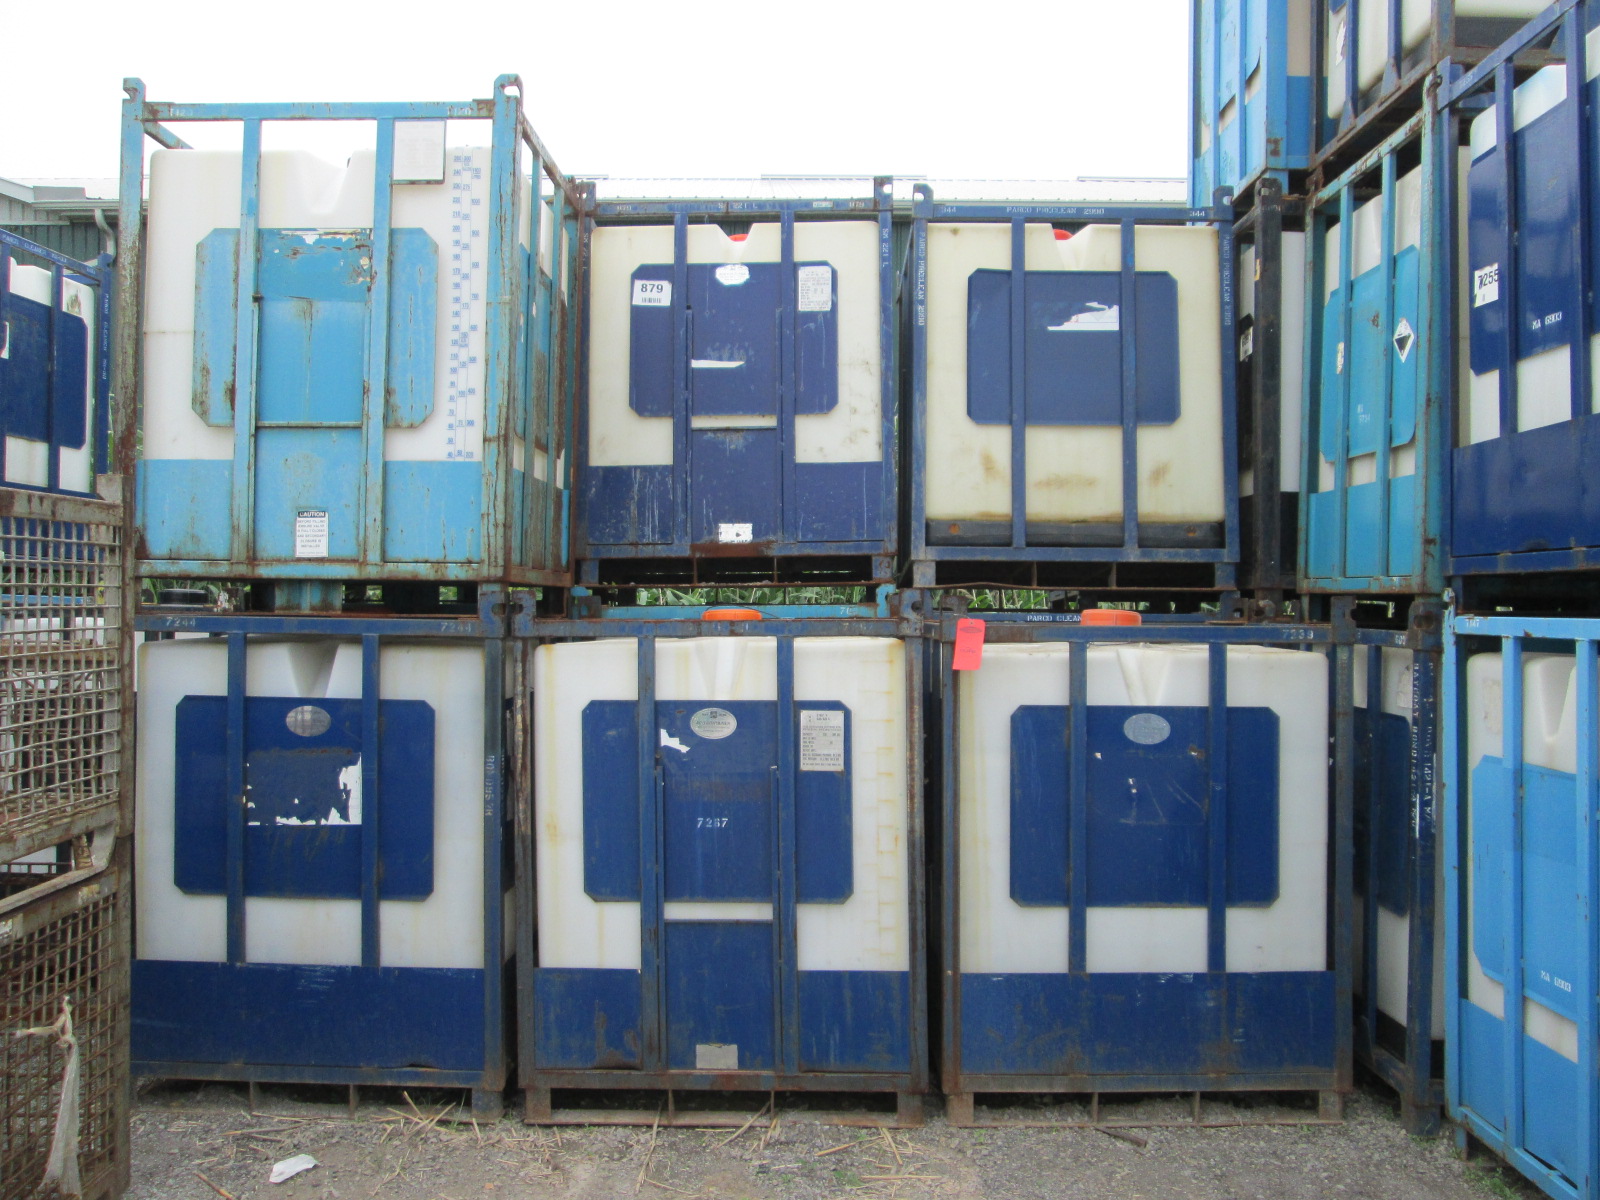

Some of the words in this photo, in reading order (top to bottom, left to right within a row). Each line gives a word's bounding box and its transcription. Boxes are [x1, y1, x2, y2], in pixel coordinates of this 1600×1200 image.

[918, 232, 926, 257] PARCO
[1223, 235, 1231, 259] PARCO
[640, 282, 664, 294] 879
[918, 260, 926, 300] PRECLEAN
[1223, 263, 1231, 302] PRECLEAN
[1478, 268, 1499, 290] 7255
[165, 617, 197, 628] 7244
[440, 621, 472, 632] 7244
[1027, 615, 1053, 623] PARCO
